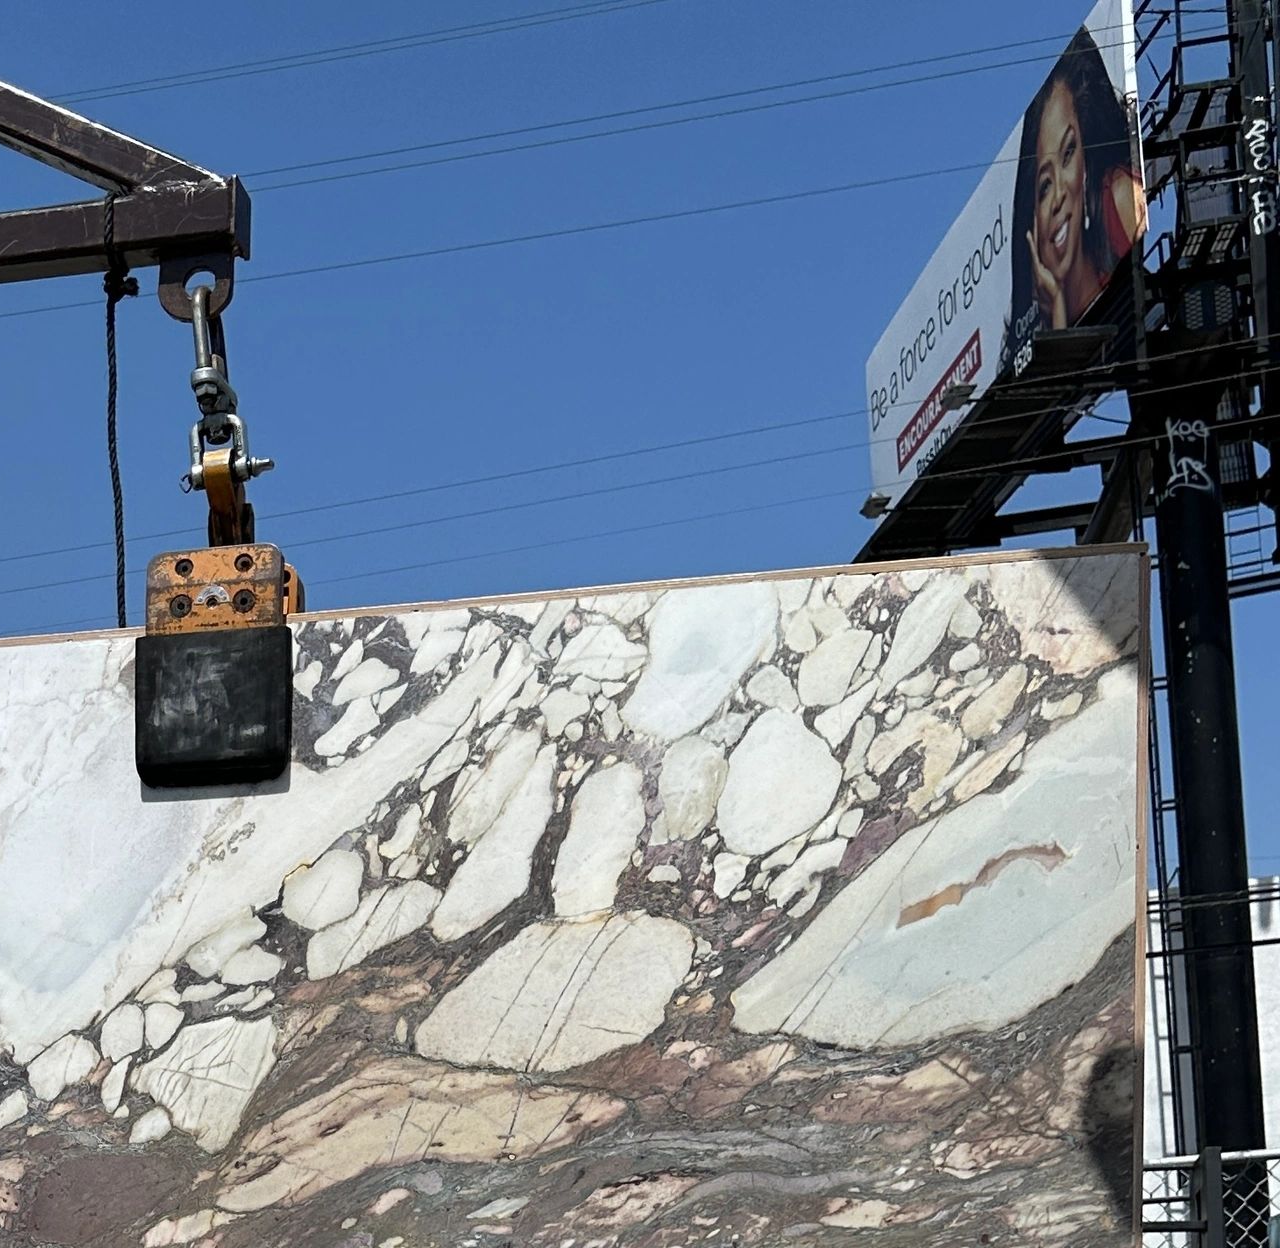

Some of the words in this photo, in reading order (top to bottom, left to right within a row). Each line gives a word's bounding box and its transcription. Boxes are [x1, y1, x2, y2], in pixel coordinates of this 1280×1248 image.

[870, 387, 888, 432] Be
[889, 372, 899, 404] a
[899, 317, 936, 390] force
[937, 277, 959, 336] for
[962, 203, 1008, 310] good.
[1013, 339, 1033, 377] 1526
